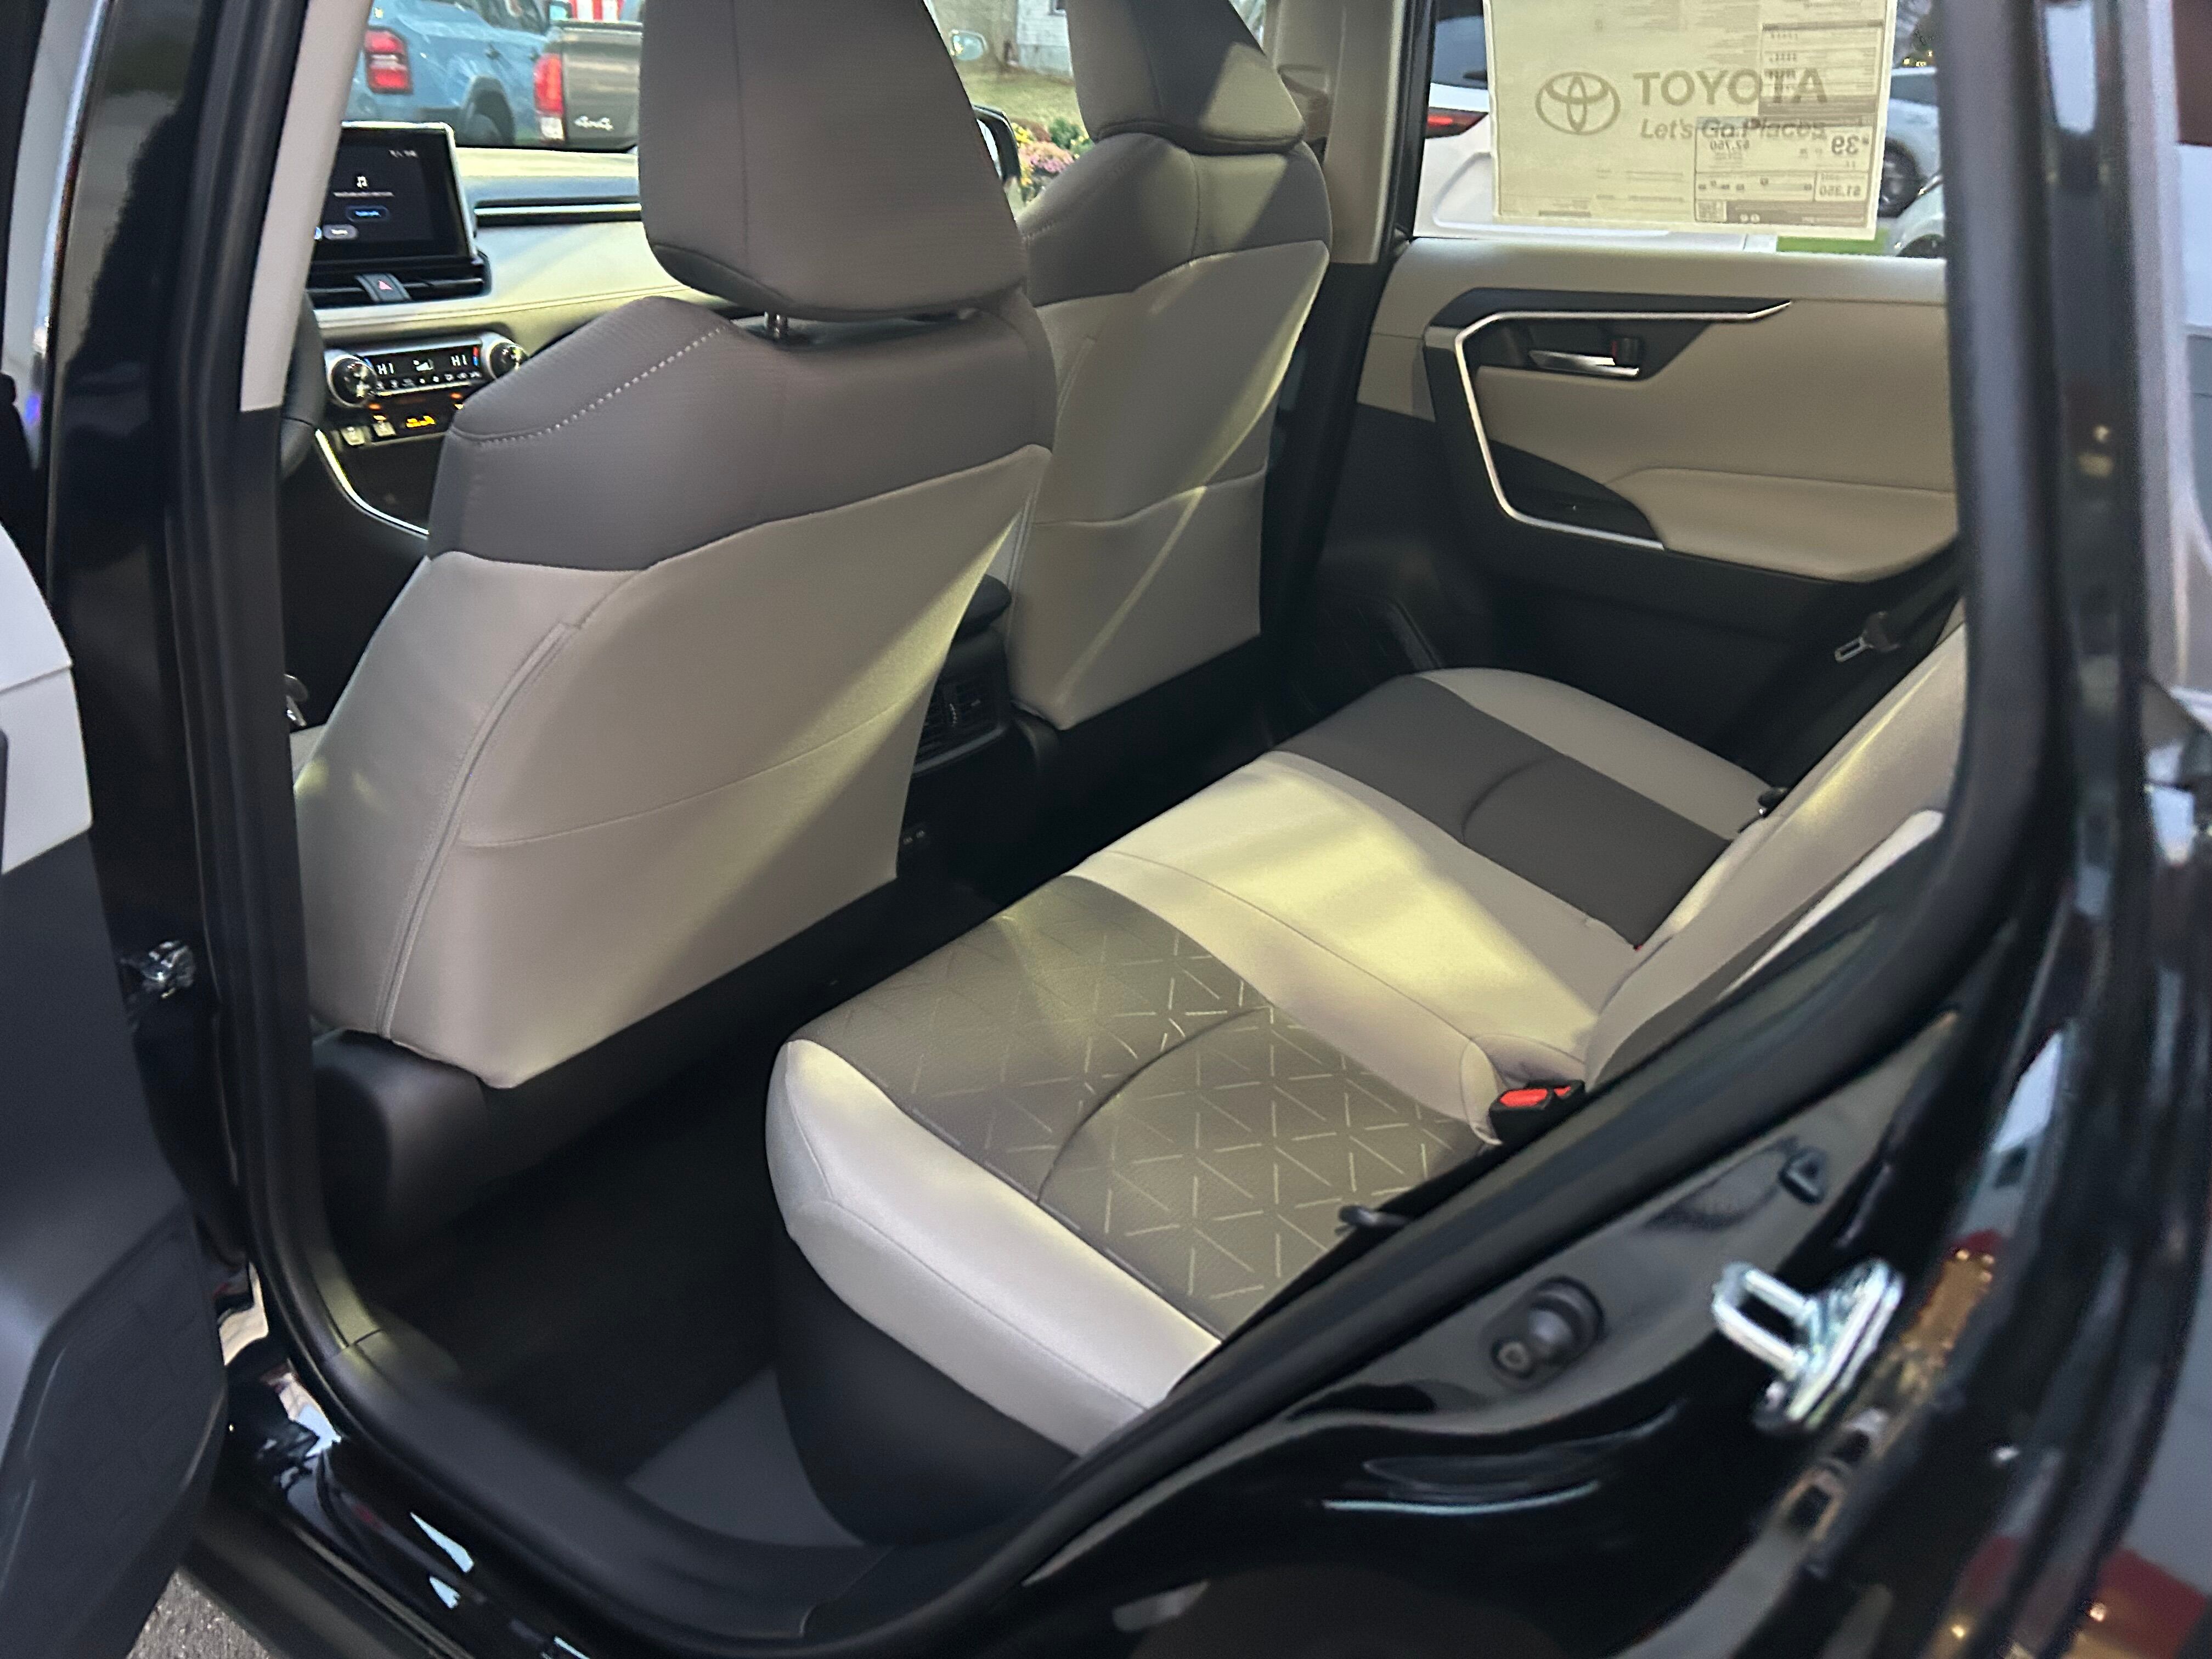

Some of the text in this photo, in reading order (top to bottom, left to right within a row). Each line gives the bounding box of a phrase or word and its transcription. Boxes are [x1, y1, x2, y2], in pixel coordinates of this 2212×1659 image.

[1633, 68, 1827, 106] TOYOTA
[1640, 117, 1826, 140] Let's Go Places
